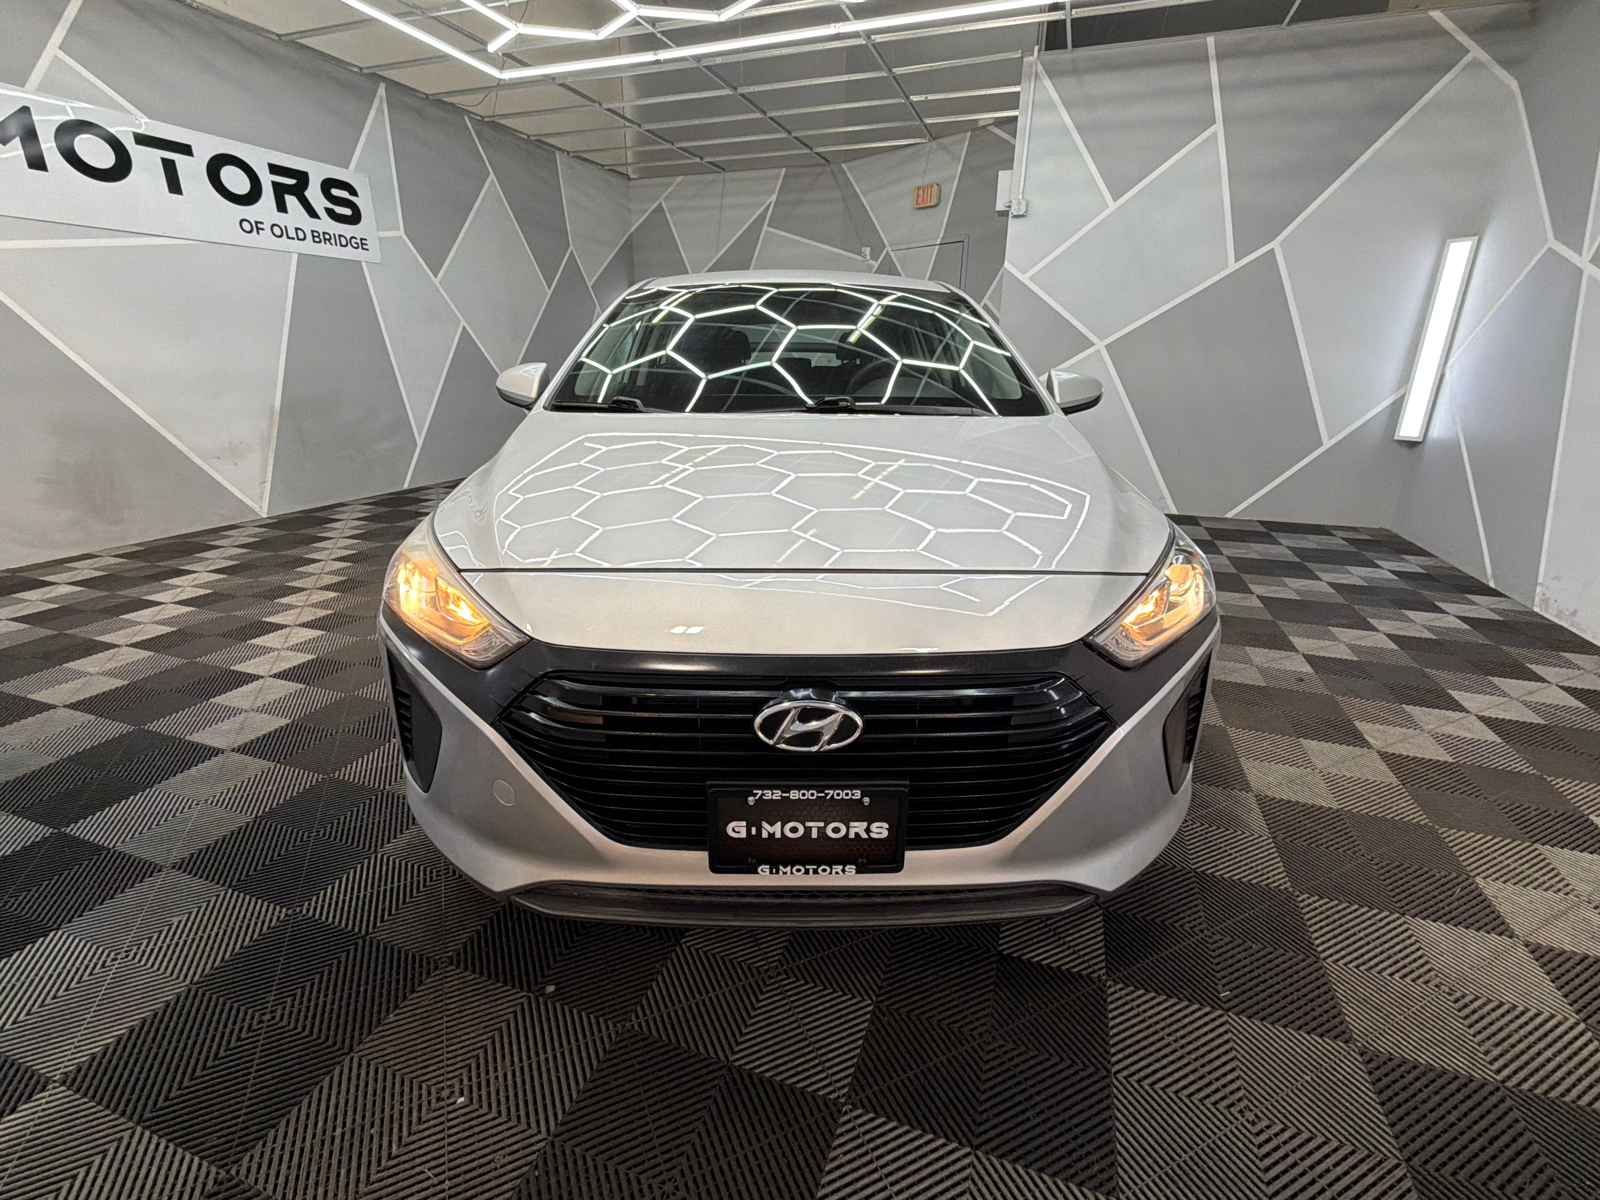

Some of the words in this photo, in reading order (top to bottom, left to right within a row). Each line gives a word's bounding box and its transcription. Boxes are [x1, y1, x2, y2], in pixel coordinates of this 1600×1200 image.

[915, 185, 934, 206] EXIT
[239, 218, 266, 236] OF
[270, 223, 307, 242] OLD
[310, 229, 370, 252] BRIDGE
[752, 790, 862, 800] 732-800-7003
